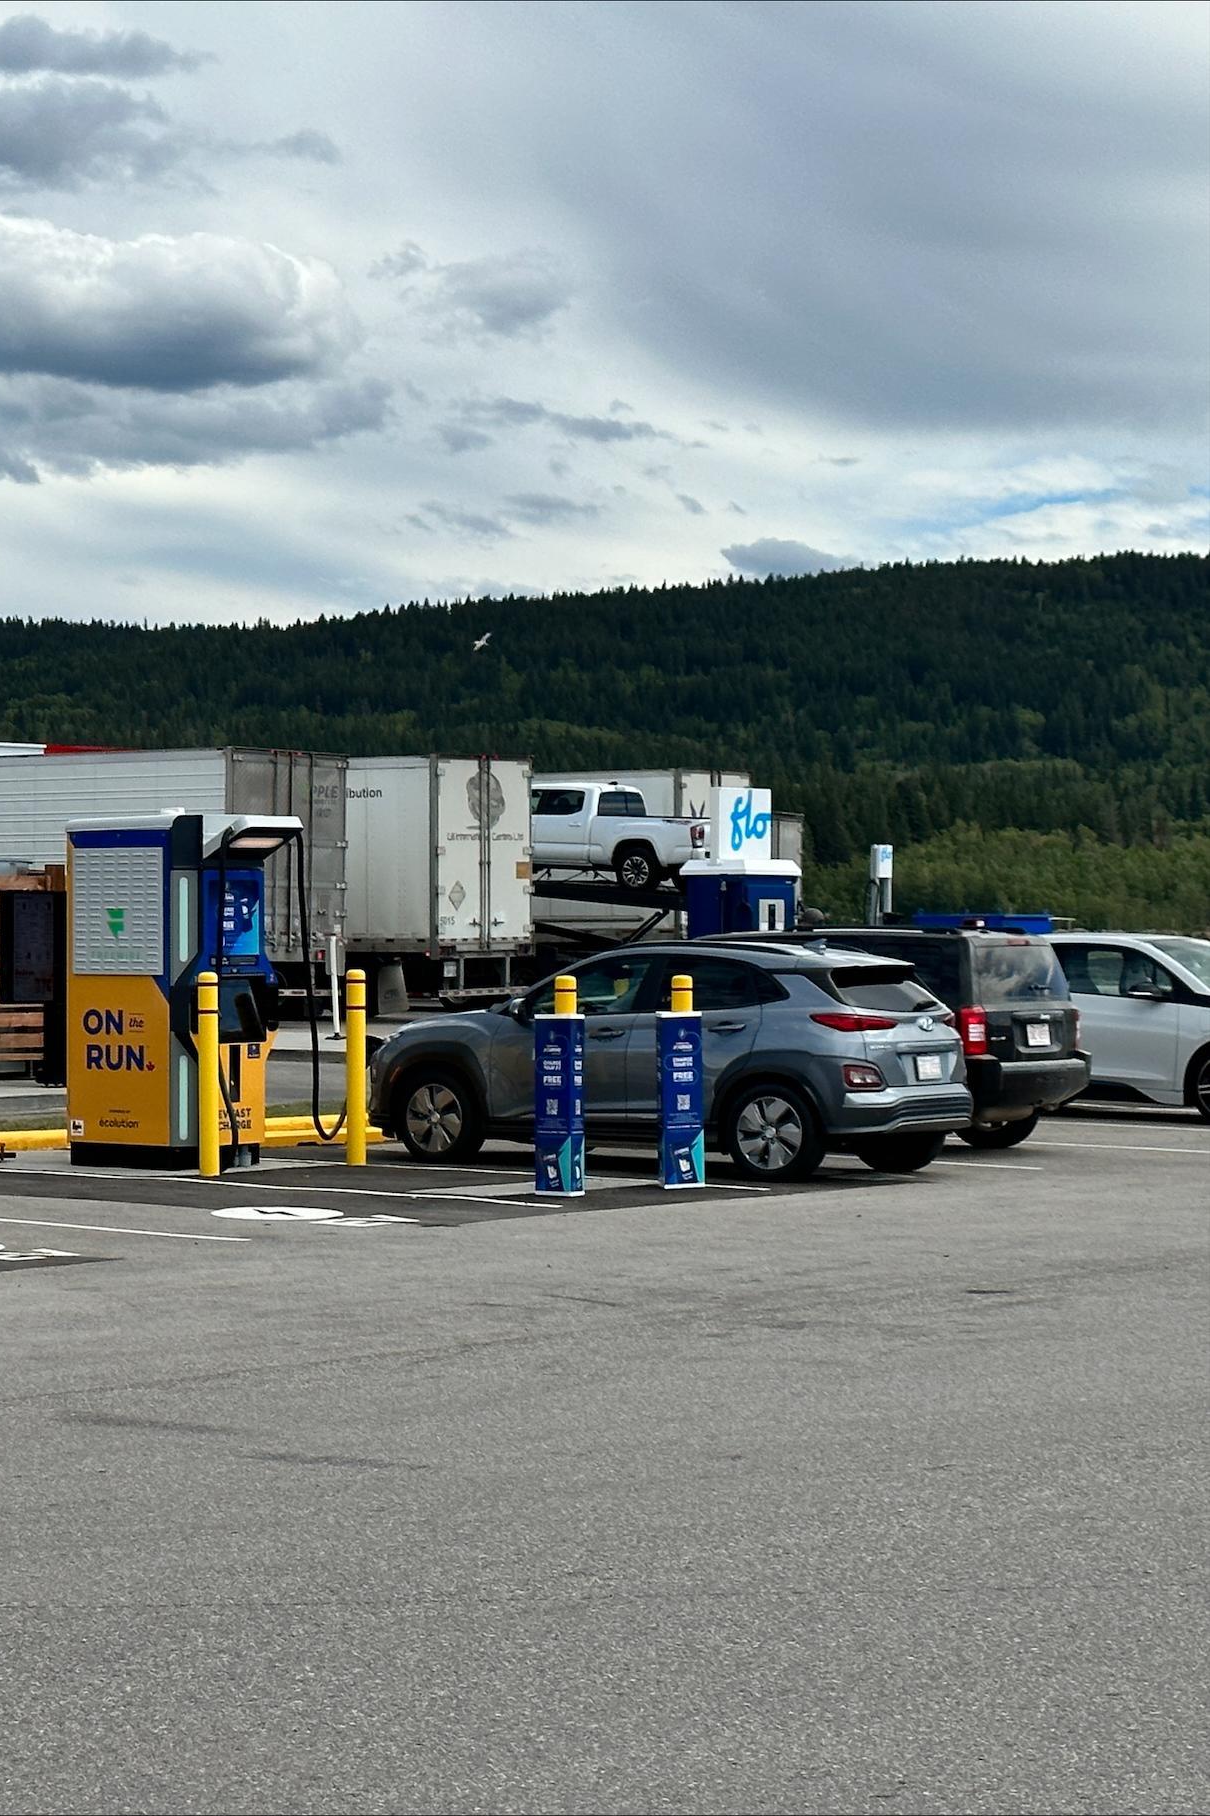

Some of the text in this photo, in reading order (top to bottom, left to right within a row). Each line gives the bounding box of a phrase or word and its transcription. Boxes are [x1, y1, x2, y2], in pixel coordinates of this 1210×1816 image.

[730, 790, 773, 851] flo
[83, 1009, 145, 1035] ON the
